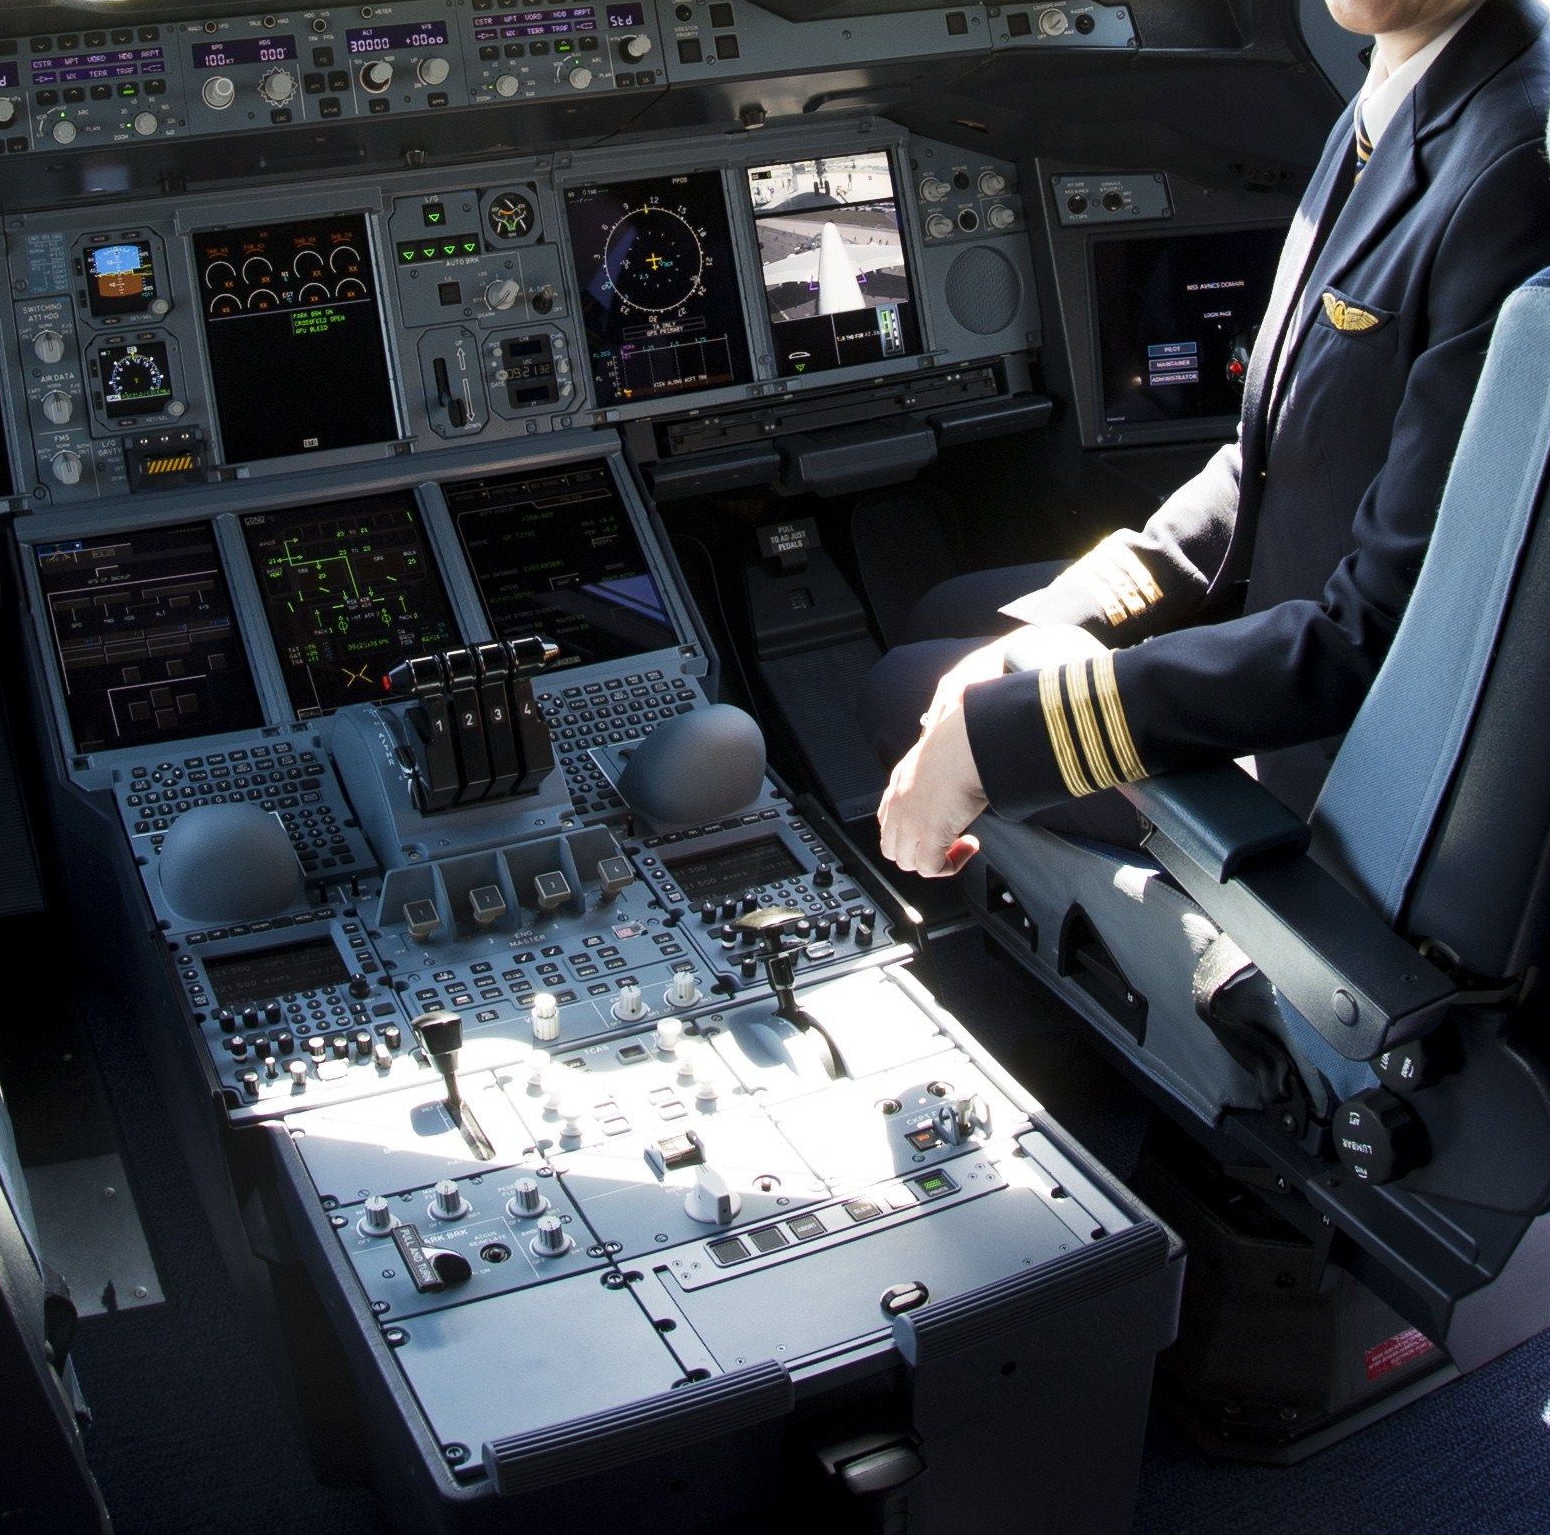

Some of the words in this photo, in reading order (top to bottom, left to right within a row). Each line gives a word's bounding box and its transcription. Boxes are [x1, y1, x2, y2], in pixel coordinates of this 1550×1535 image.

[610, 14, 633, 28] Std
[526, 26, 544, 35] TERR
[350, 38, 390, 52] 30000
[140, 49, 160, 58] ARPT
[89, 69, 108, 78] TERR
[650, 196, 659, 204] 12
[677, 205, 687, 215] 15
[445, 258, 462, 267] AUTO
[462, 256, 479, 265] BRK
[22, 303, 62, 315] SWITCHING
[28, 313, 44, 321] ATT
[44, 311, 60, 321] HDG
[660, 326, 683, 335] PRIMARY
[40, 375, 52, 383] AIR
[53, 372, 75, 382] DATA
[54, 435, 70, 443] FMS
[244, 515, 266, 525] COND
[778, 526, 794, 534] PULL
[778, 540, 803, 551] PEDALS
[494, 708, 503, 721] 3
[524, 703, 531, 716] 4
[465, 713, 474, 726] 2
[436, 720, 444, 732] 1
[509, 934, 546, 947] MASTER
[400, 1227, 415, 1248] PULL
[449, 1229, 469, 1241] BRK
